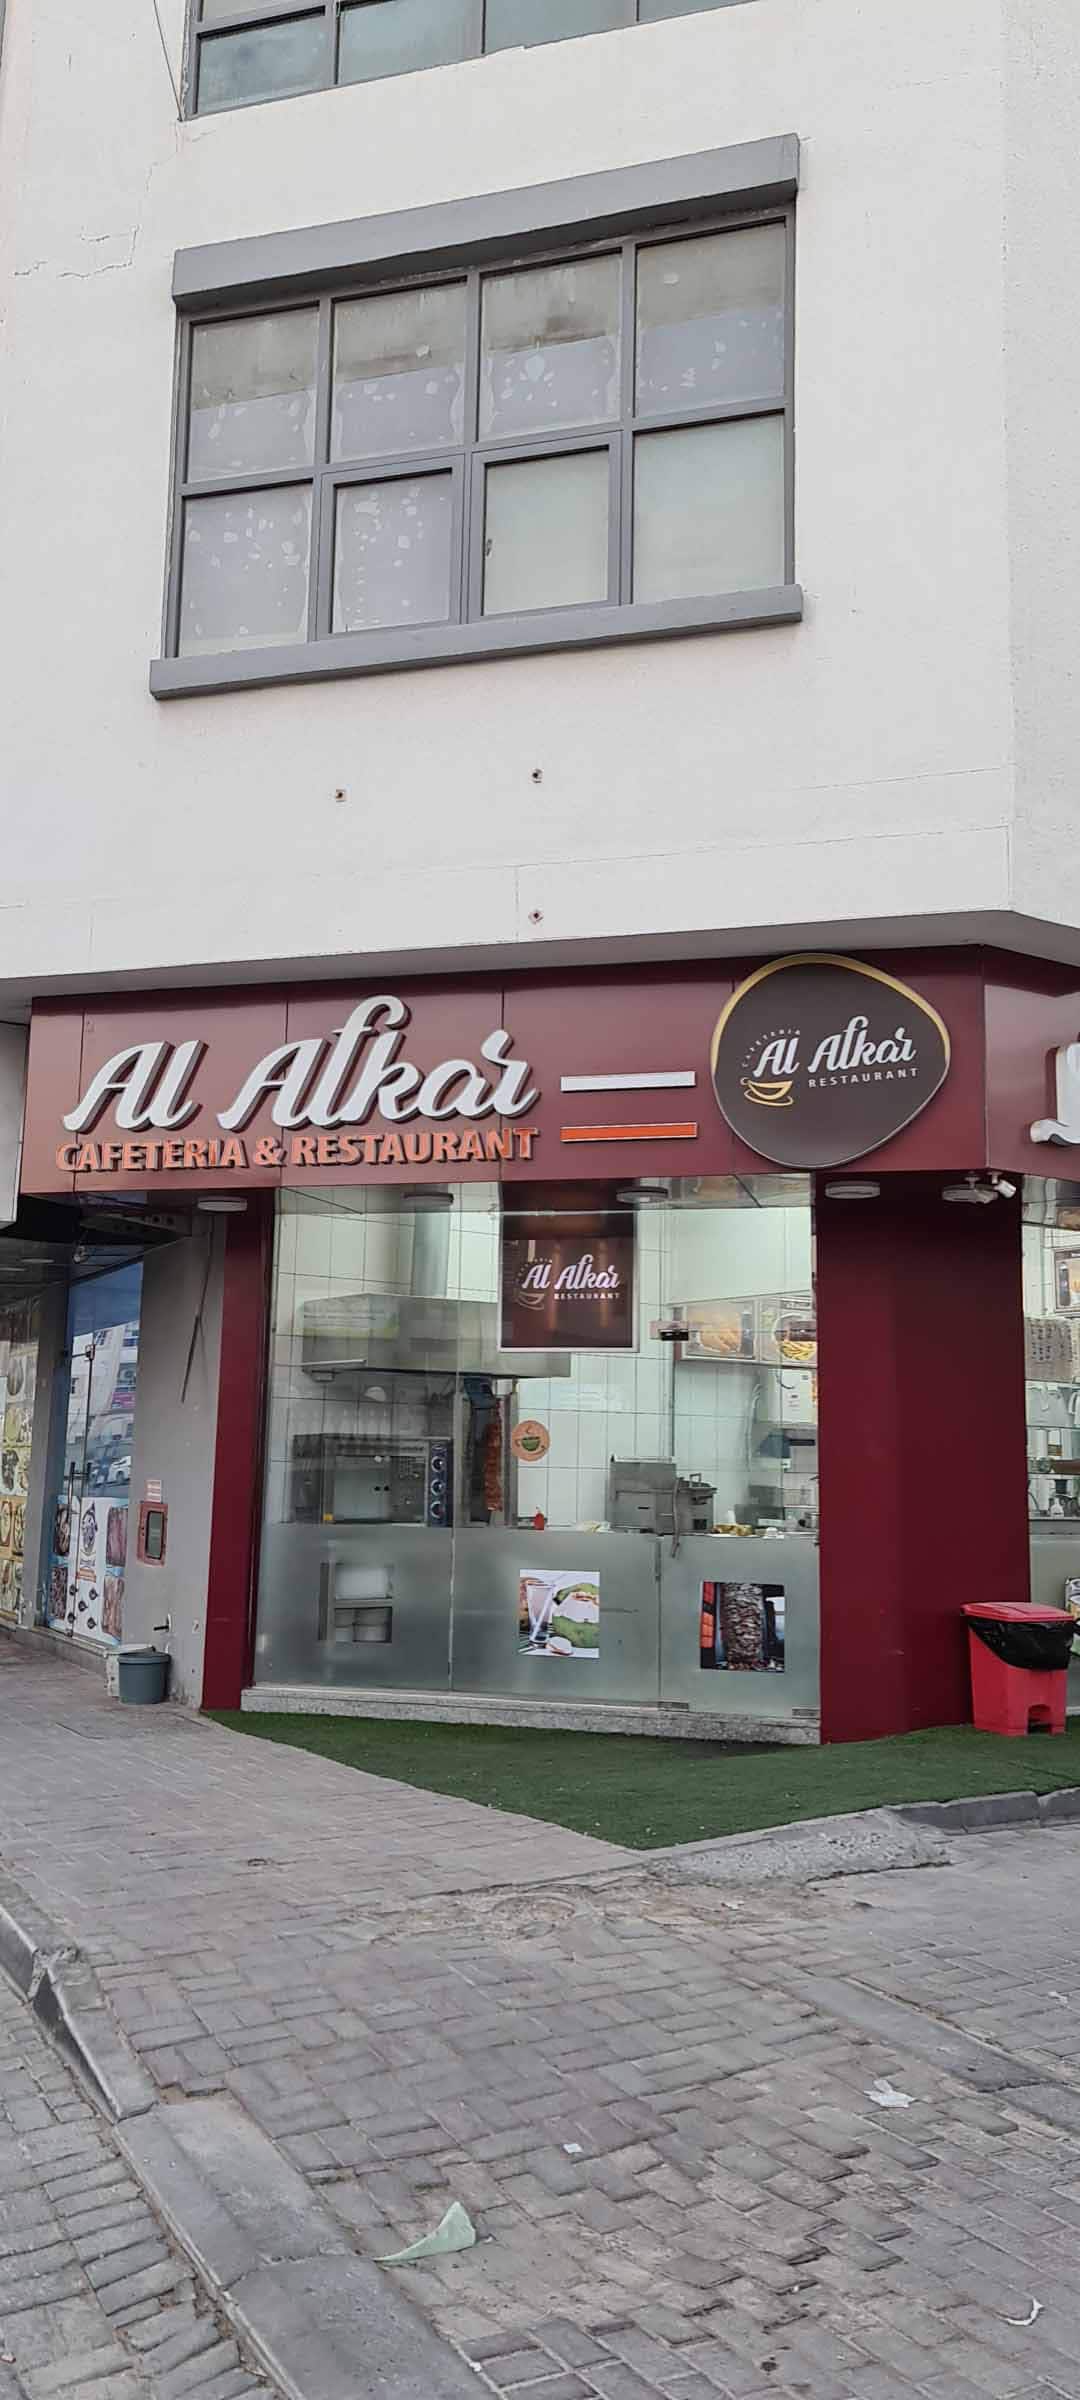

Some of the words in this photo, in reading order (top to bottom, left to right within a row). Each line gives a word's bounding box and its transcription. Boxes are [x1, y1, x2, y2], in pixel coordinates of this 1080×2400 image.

[62, 1039, 210, 1135] Al
[215, 994, 541, 1134] Afkar
[753, 1037, 799, 1078] Al
[807, 1015, 917, 1073] Afkar
[808, 1067, 919, 1088] RESTAURANT
[55, 1136, 250, 1173] CAFETERIA
[254, 1134, 286, 1168] &
[290, 1127, 540, 1168] RESTAURANT
[522, 1264, 552, 1289] Al
[554, 1254, 620, 1290] Afkar
[554, 1292, 620, 1300] RESTAURANT
